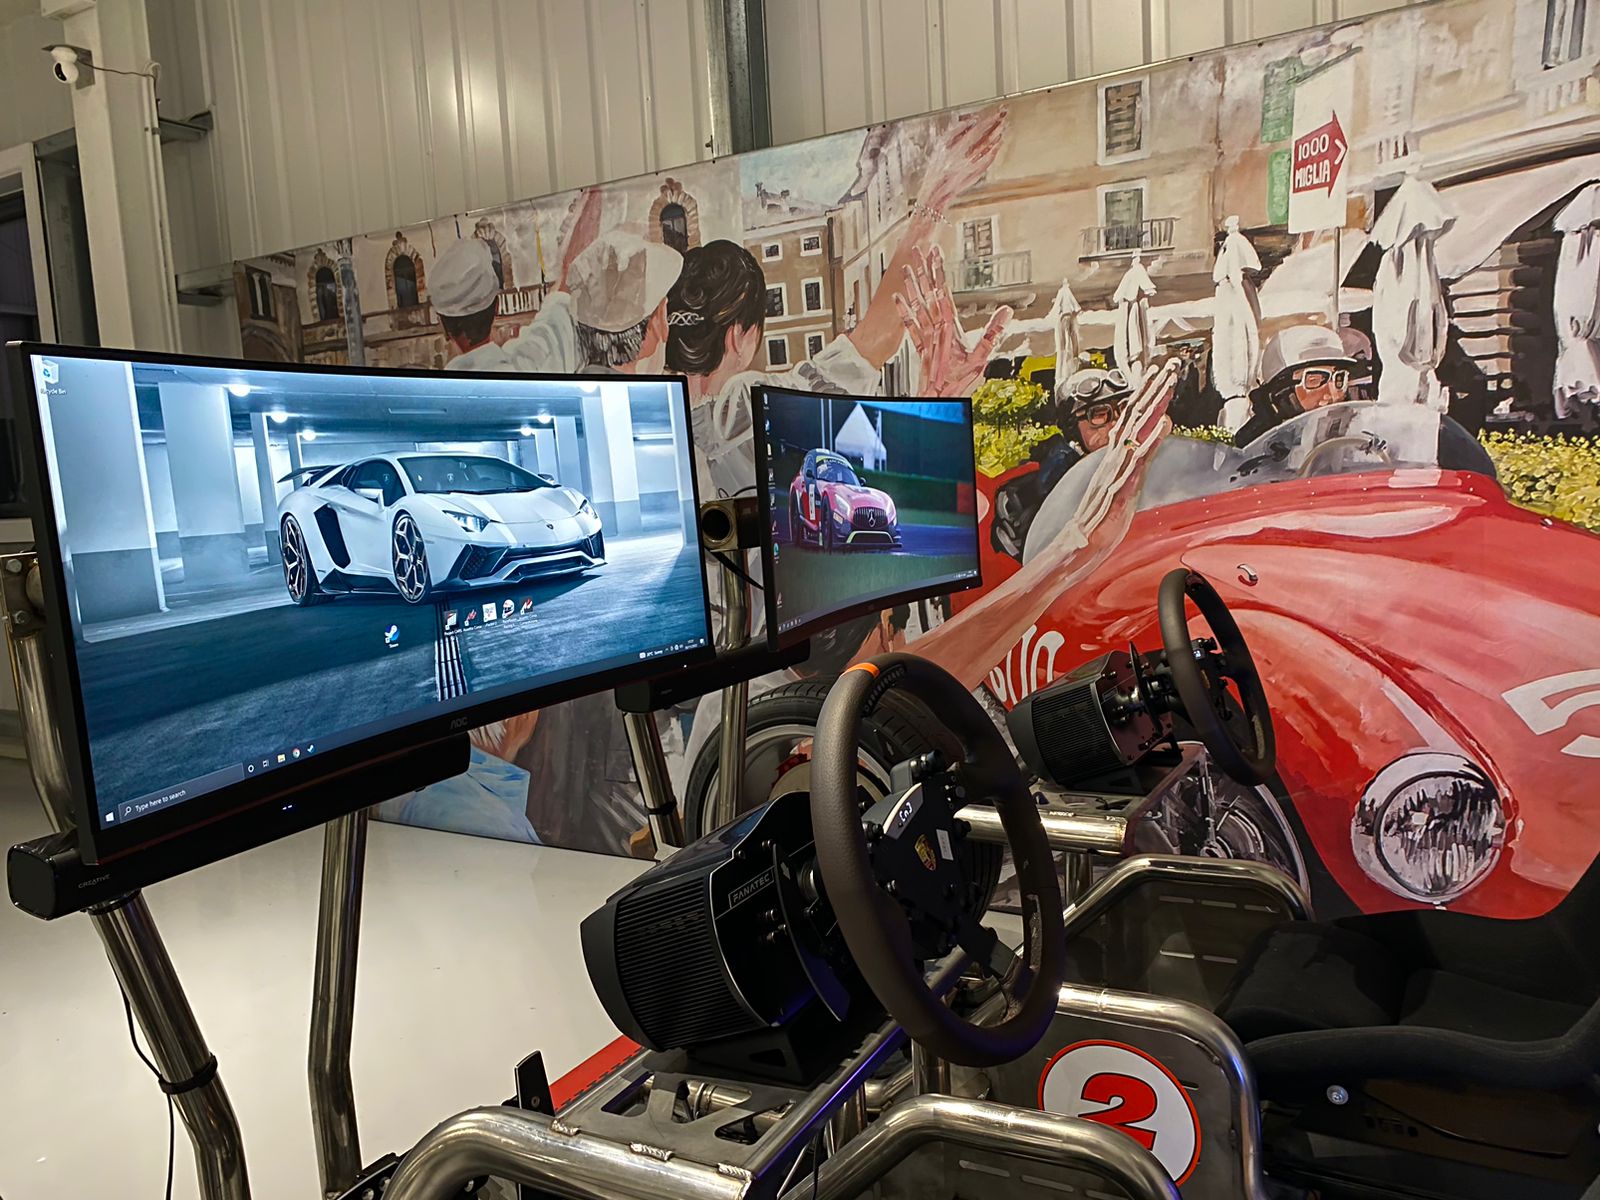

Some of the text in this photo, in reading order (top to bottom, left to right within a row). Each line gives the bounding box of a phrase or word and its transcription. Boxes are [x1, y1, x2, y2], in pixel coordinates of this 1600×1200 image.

[1298, 133, 1330, 161] 1000
[1294, 159, 1331, 188] MIGLIA
[135, 802, 149, 812] Type
[149, 798, 161, 807] here
[169, 789, 186, 801] search
[78, 873, 110, 889] CREATIVE
[732, 873, 770, 903] FANATEC
[1077, 1072, 1158, 1152] 2
